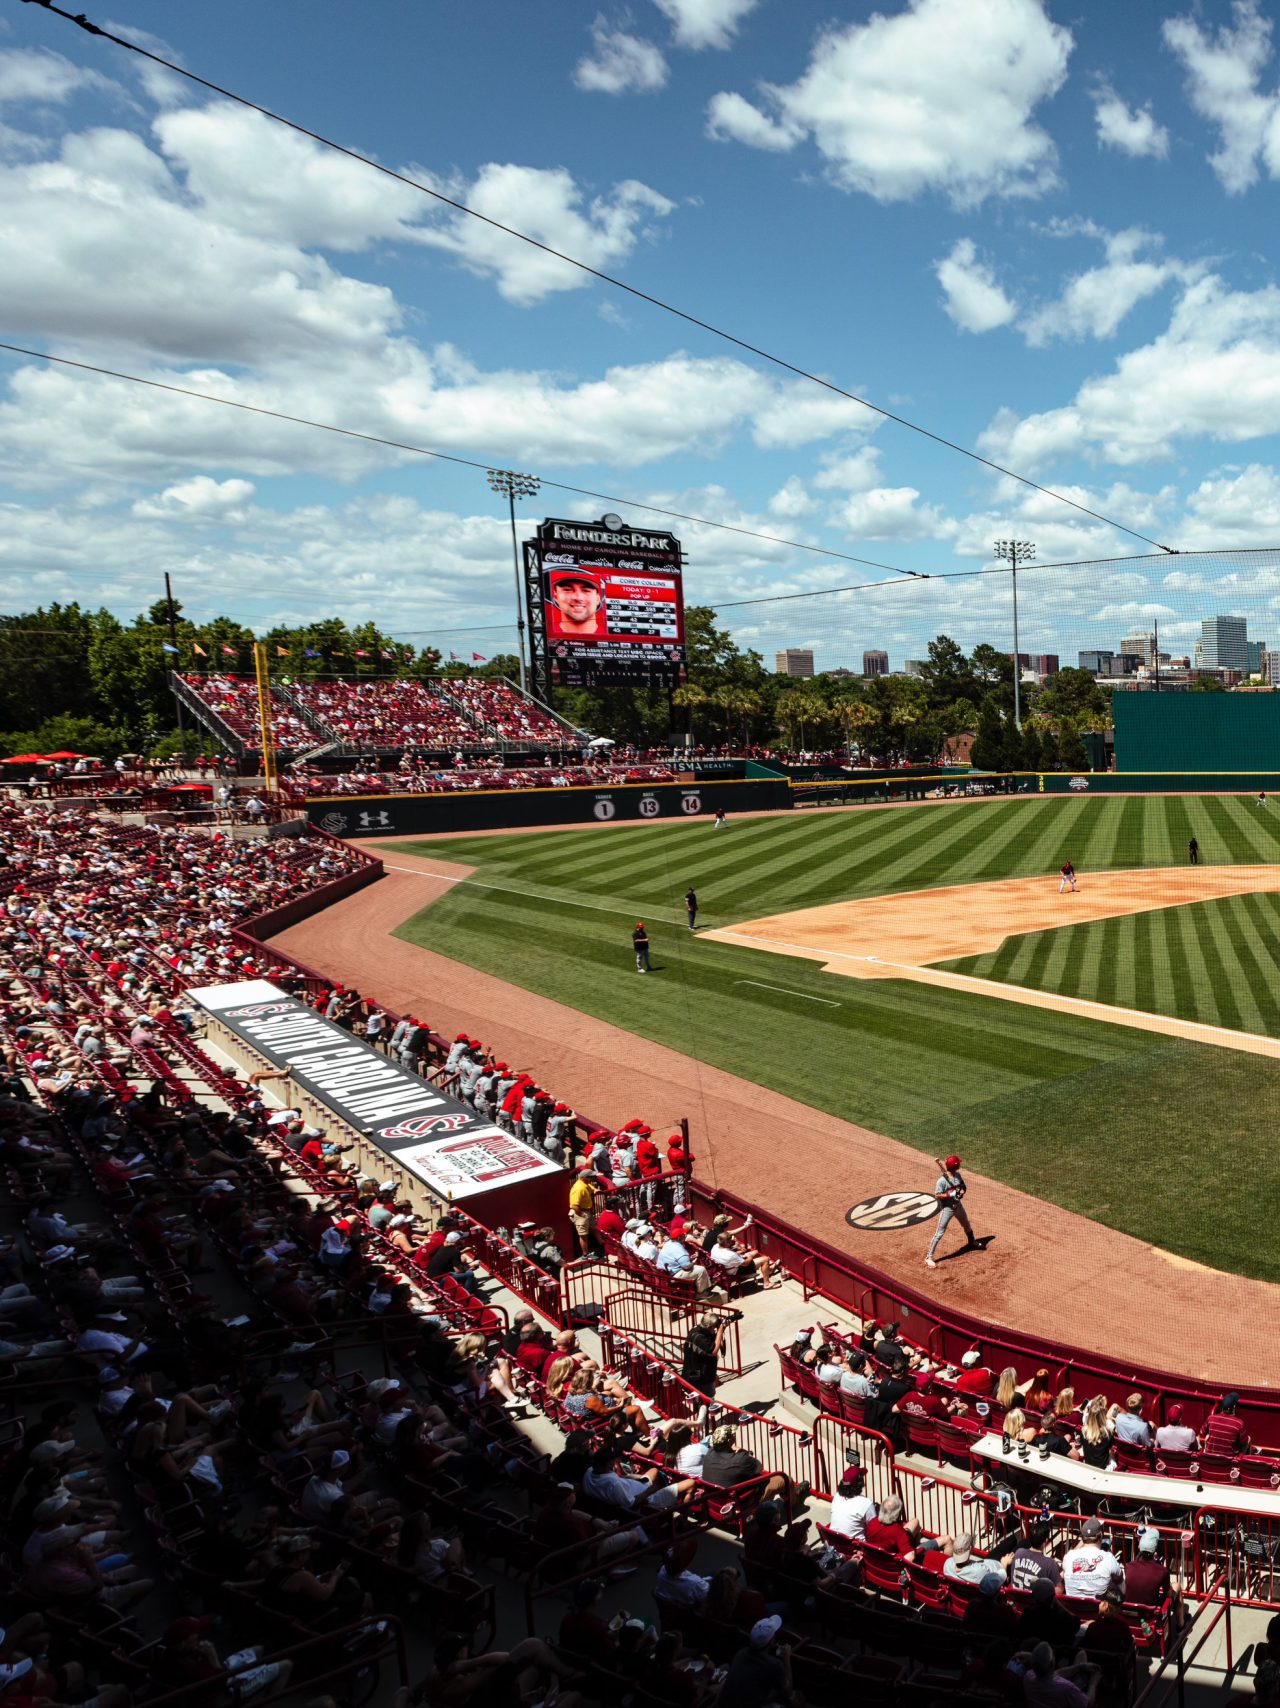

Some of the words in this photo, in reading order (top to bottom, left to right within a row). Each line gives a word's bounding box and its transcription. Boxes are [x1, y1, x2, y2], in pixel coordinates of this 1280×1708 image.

[554, 524, 630, 546] FOUNDERS
[631, 532, 670, 550] PARK
[594, 548, 628, 556] CAROLINA
[631, 551, 664, 559] BASEBALL
[580, 558, 603, 567] Colonial
[601, 804, 607, 816] 1
[643, 801, 656, 813] 13
[685, 799, 698, 810] 14
[238, 1012, 351, 1054] SOUTH
[286, 1046, 446, 1123] CAROLINA
[1014, 1558, 1042, 1575] MATSUI
